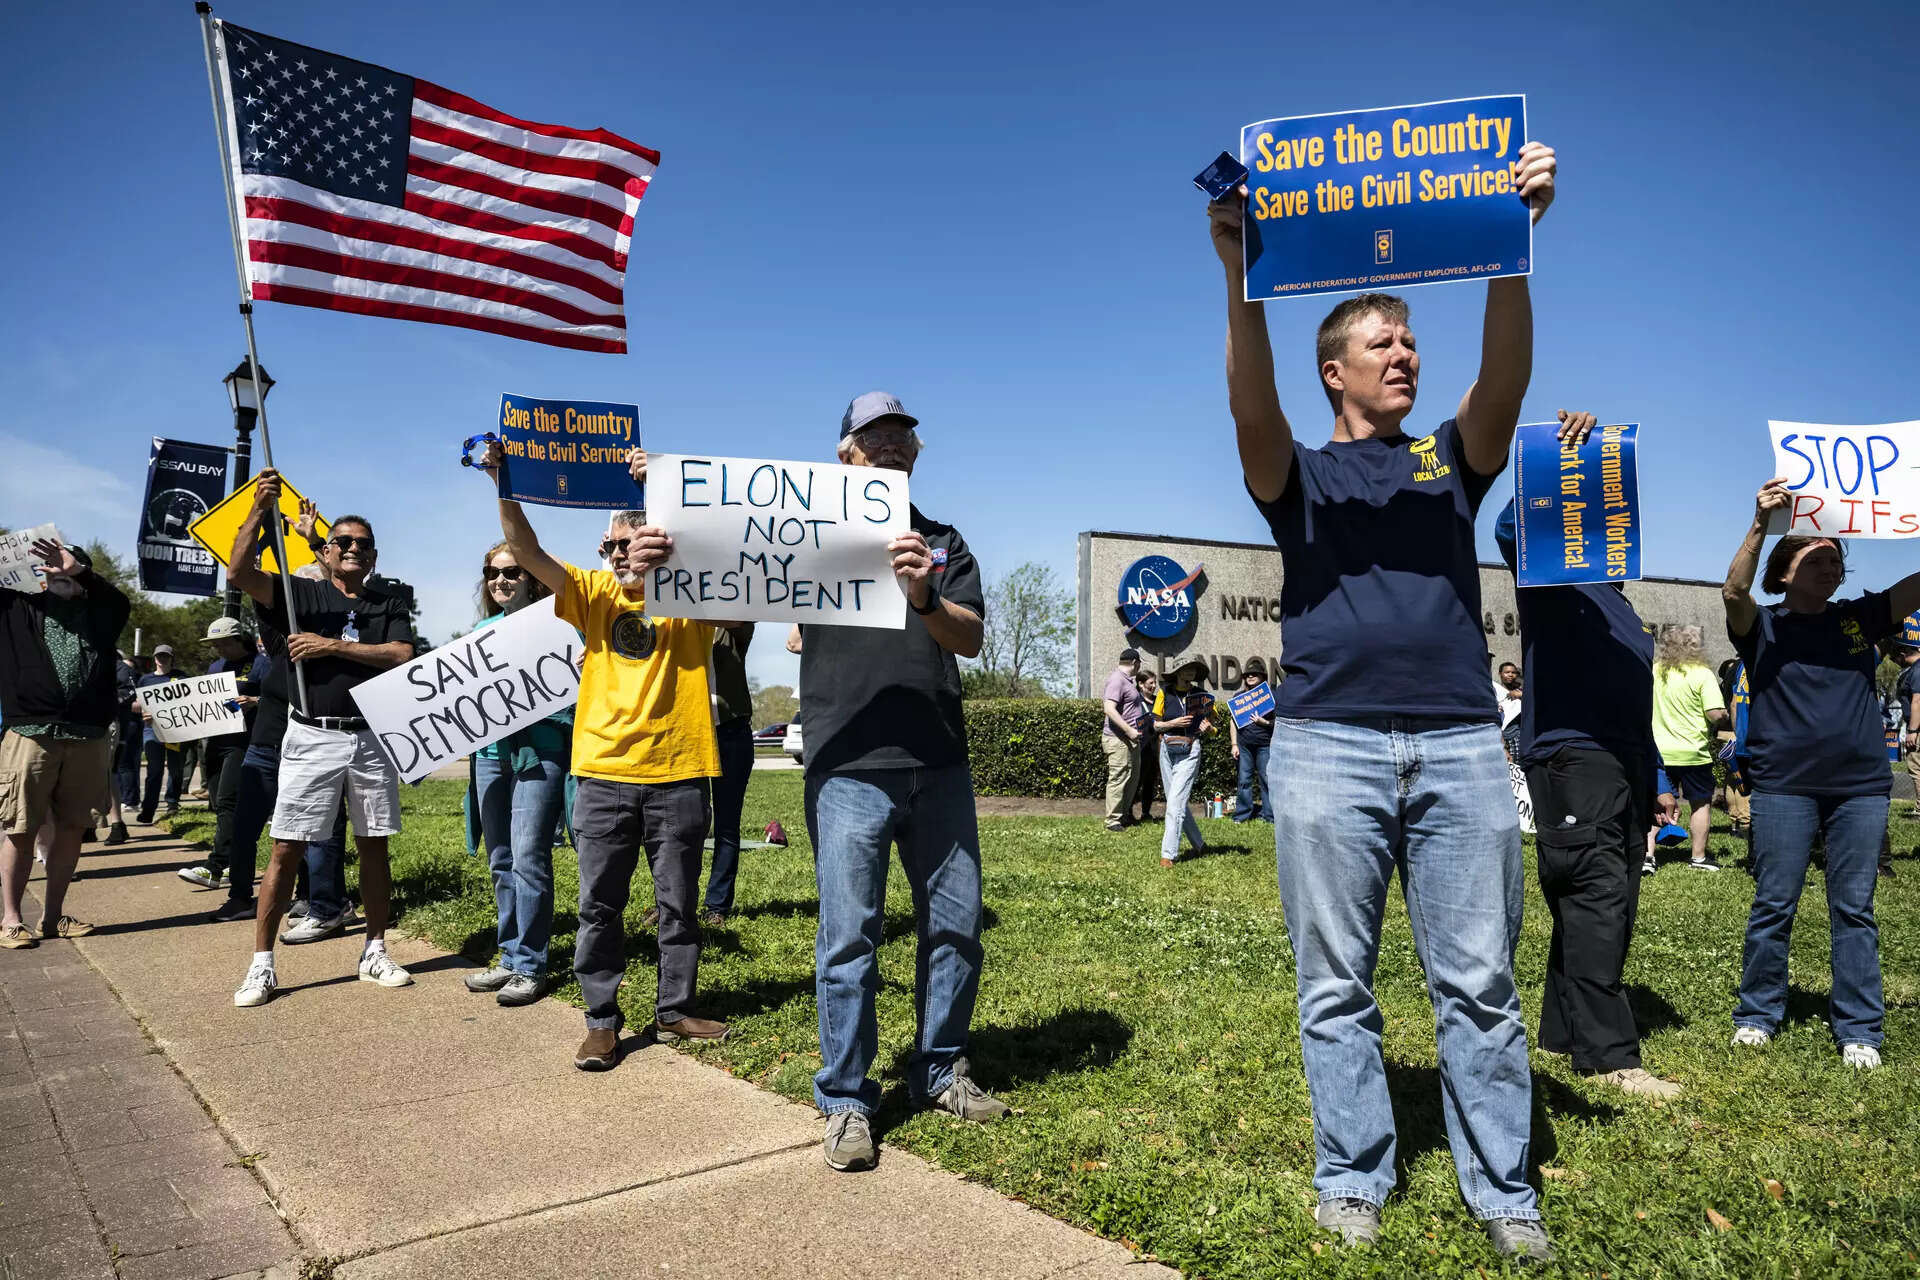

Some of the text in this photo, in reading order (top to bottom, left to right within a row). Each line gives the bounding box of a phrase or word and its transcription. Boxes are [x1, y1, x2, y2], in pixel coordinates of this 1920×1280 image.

[1256, 113, 1512, 173] Save the Country
[1255, 161, 1517, 220] Save the Civil Service!
[1273, 263, 1501, 292] AMERICAN FEDERATION OF GOVERNMENT EMPLOYEES, AFL-CIO
[503, 401, 633, 441] Save the Country
[158, 459, 196, 473] SSAU
[198, 465, 224, 477] BAY
[502, 434, 525, 457] Save
[526, 439, 546, 461] the
[549, 441, 577, 463] Civil
[1780, 433, 1900, 496] STOP
[681, 460, 891, 524] ELON IS
[1413, 471, 1435, 482] LOCAL
[1560, 473, 1585, 496] for
[1601, 425, 1633, 577] Government Workers
[1791, 495, 1919, 534] RIFs
[744, 515, 837, 549] NOT
[1562, 501, 1590, 569] America!
[175, 547, 215, 566] TREES
[739, 551, 796, 584] MY
[654, 566, 876, 611] PRESIDENT
[1127, 587, 1191, 608] NASA
[407, 629, 509, 701] SAVE
[142, 677, 231, 706] PROUD CIVIL
[379, 644, 581, 774] DEMOCRACY
